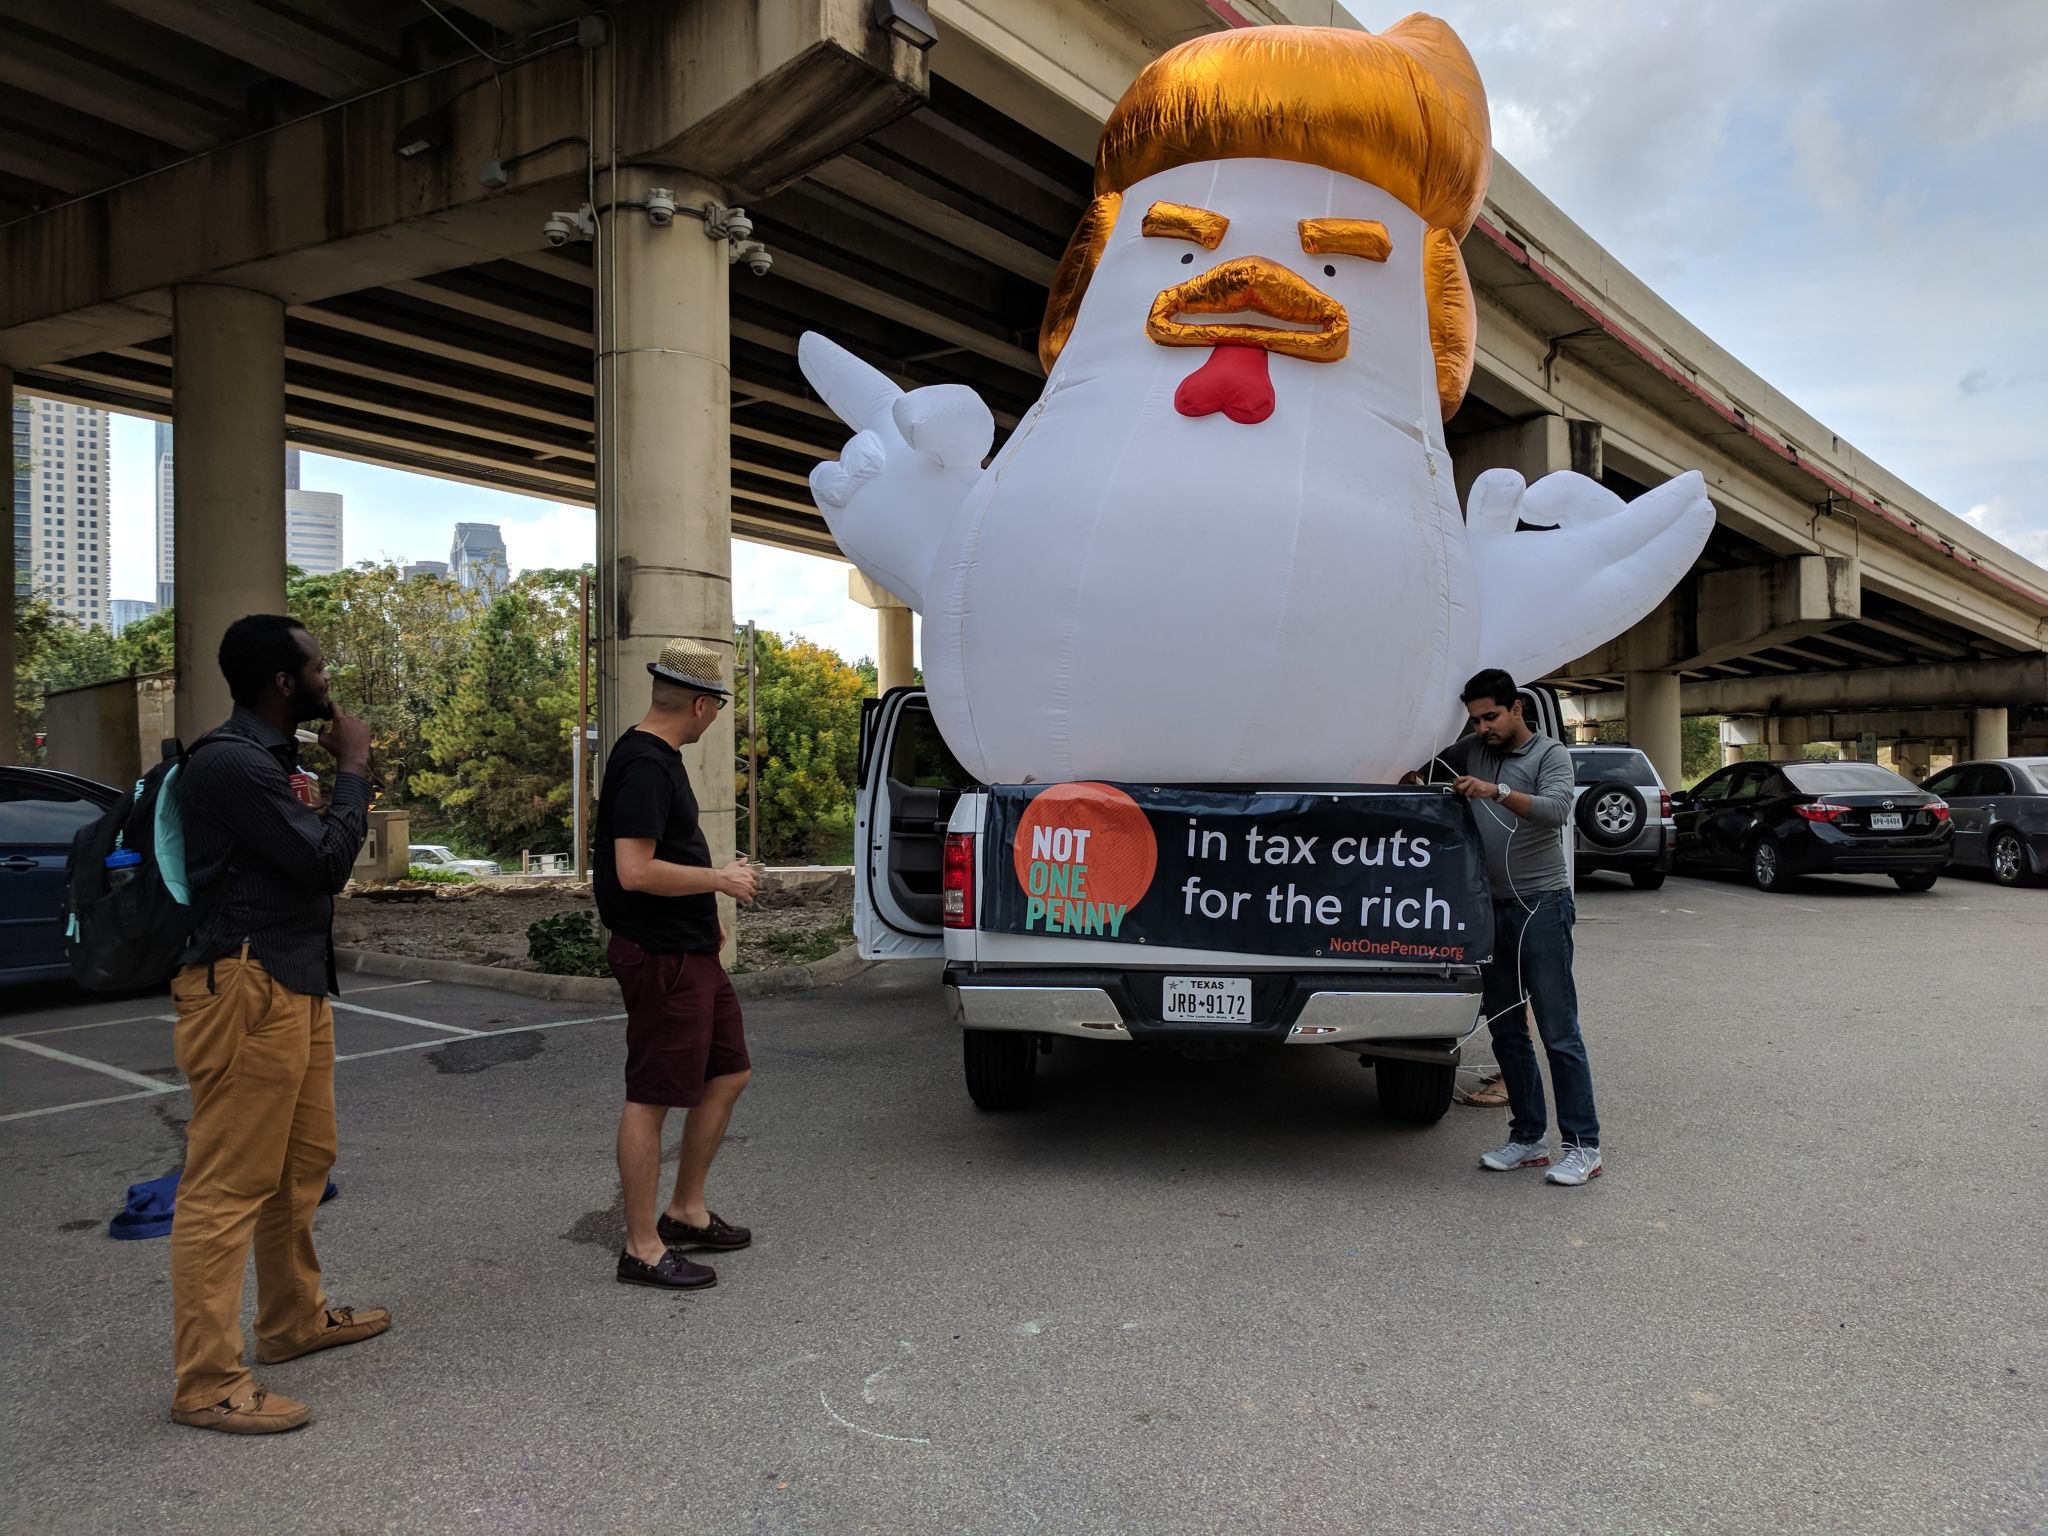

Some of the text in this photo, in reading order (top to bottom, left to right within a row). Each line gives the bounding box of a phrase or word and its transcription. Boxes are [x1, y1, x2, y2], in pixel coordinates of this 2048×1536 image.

[1032, 825, 1091, 864] NOT
[1187, 818, 1431, 868] in tax cuts
[1029, 861, 1088, 899] ONE
[1025, 896, 1128, 938] PENNY
[1181, 876, 1466, 931] for the rich.
[1329, 937, 1465, 960] NotOnePenny.org
[1190, 980, 1225, 990] TEXAS
